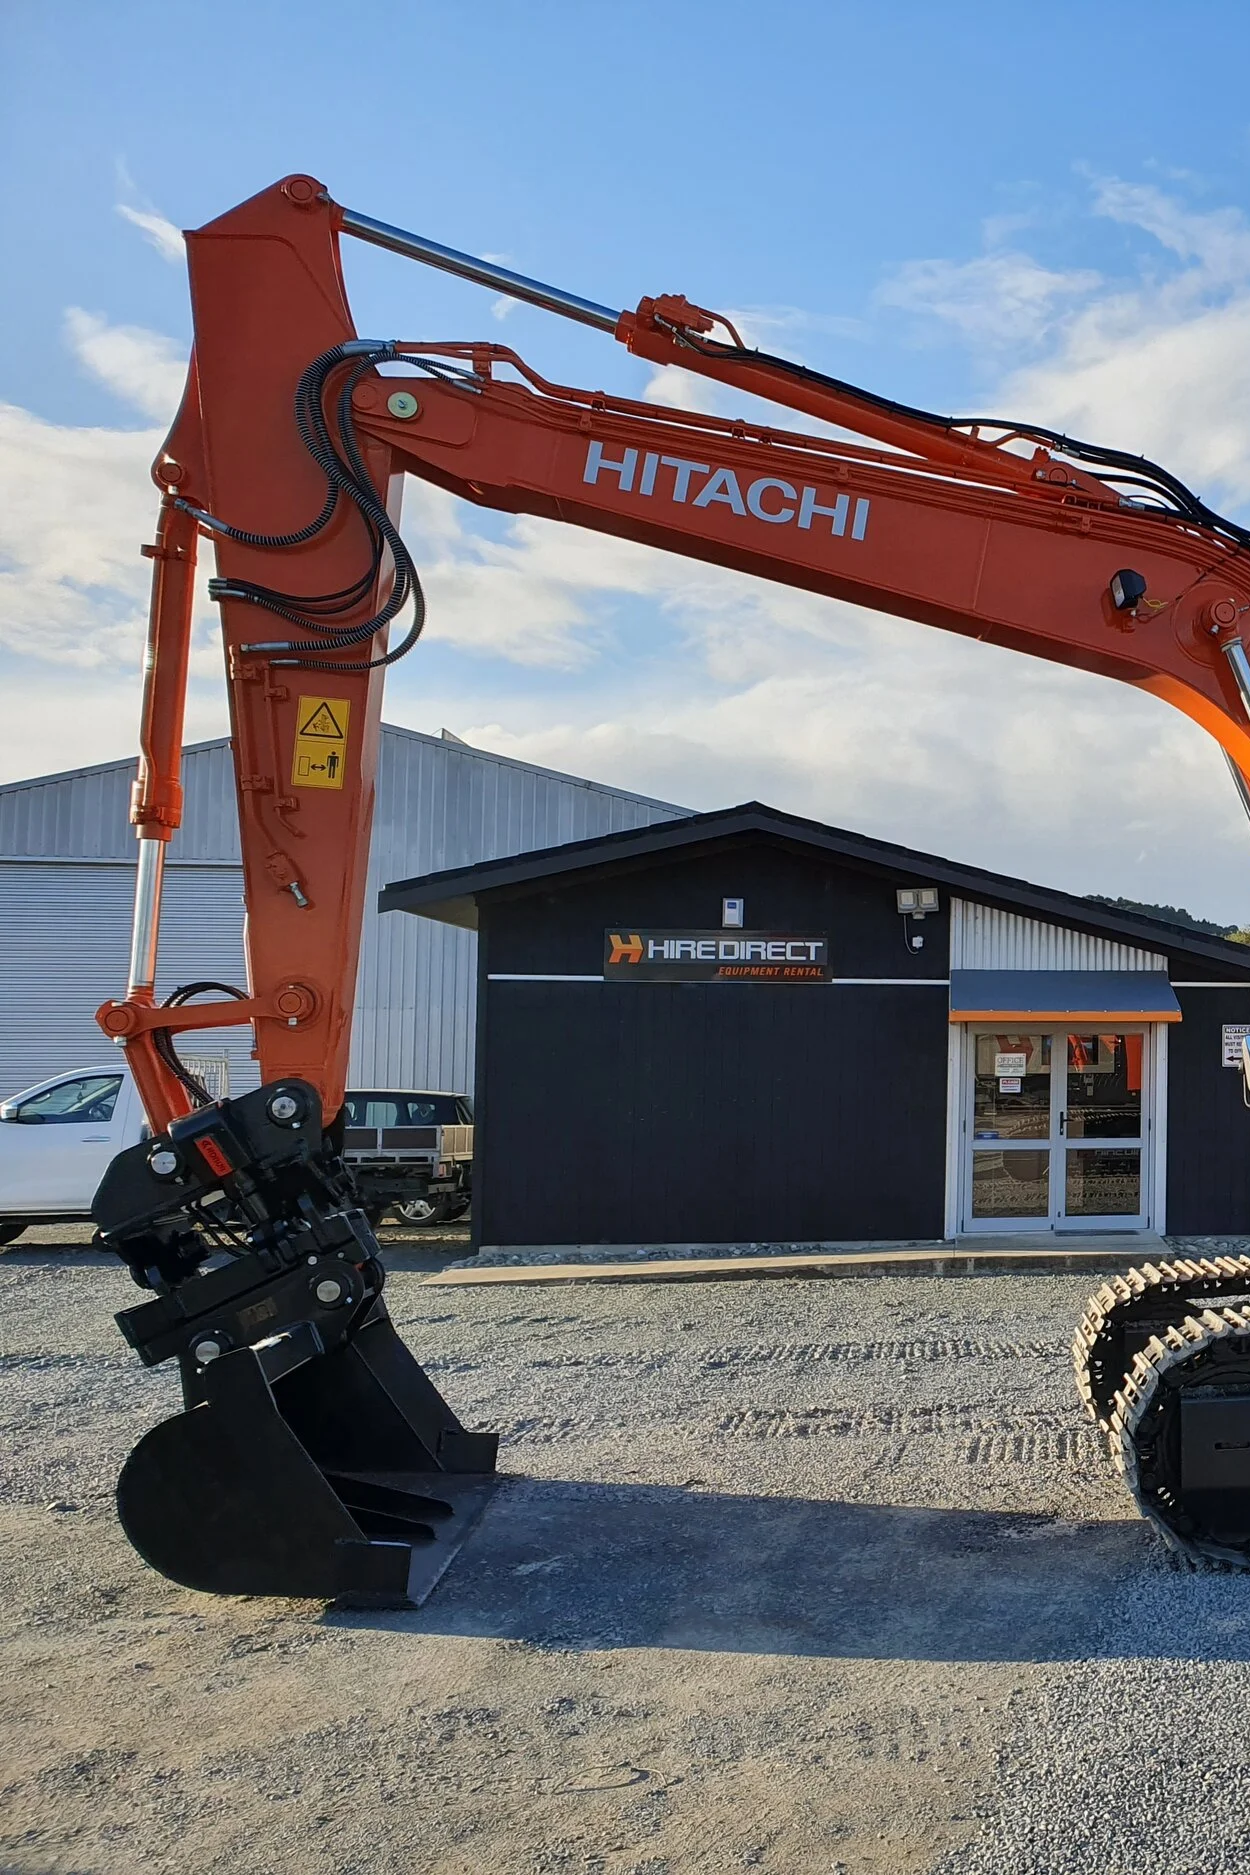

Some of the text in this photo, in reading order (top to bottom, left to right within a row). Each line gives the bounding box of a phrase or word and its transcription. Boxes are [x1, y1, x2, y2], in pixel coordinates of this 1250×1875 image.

[582, 439, 870, 541] HITACHI
[718, 966, 824, 976] EQUIPMENT RENTAL
[997, 1056, 1024, 1064] OFFICE
